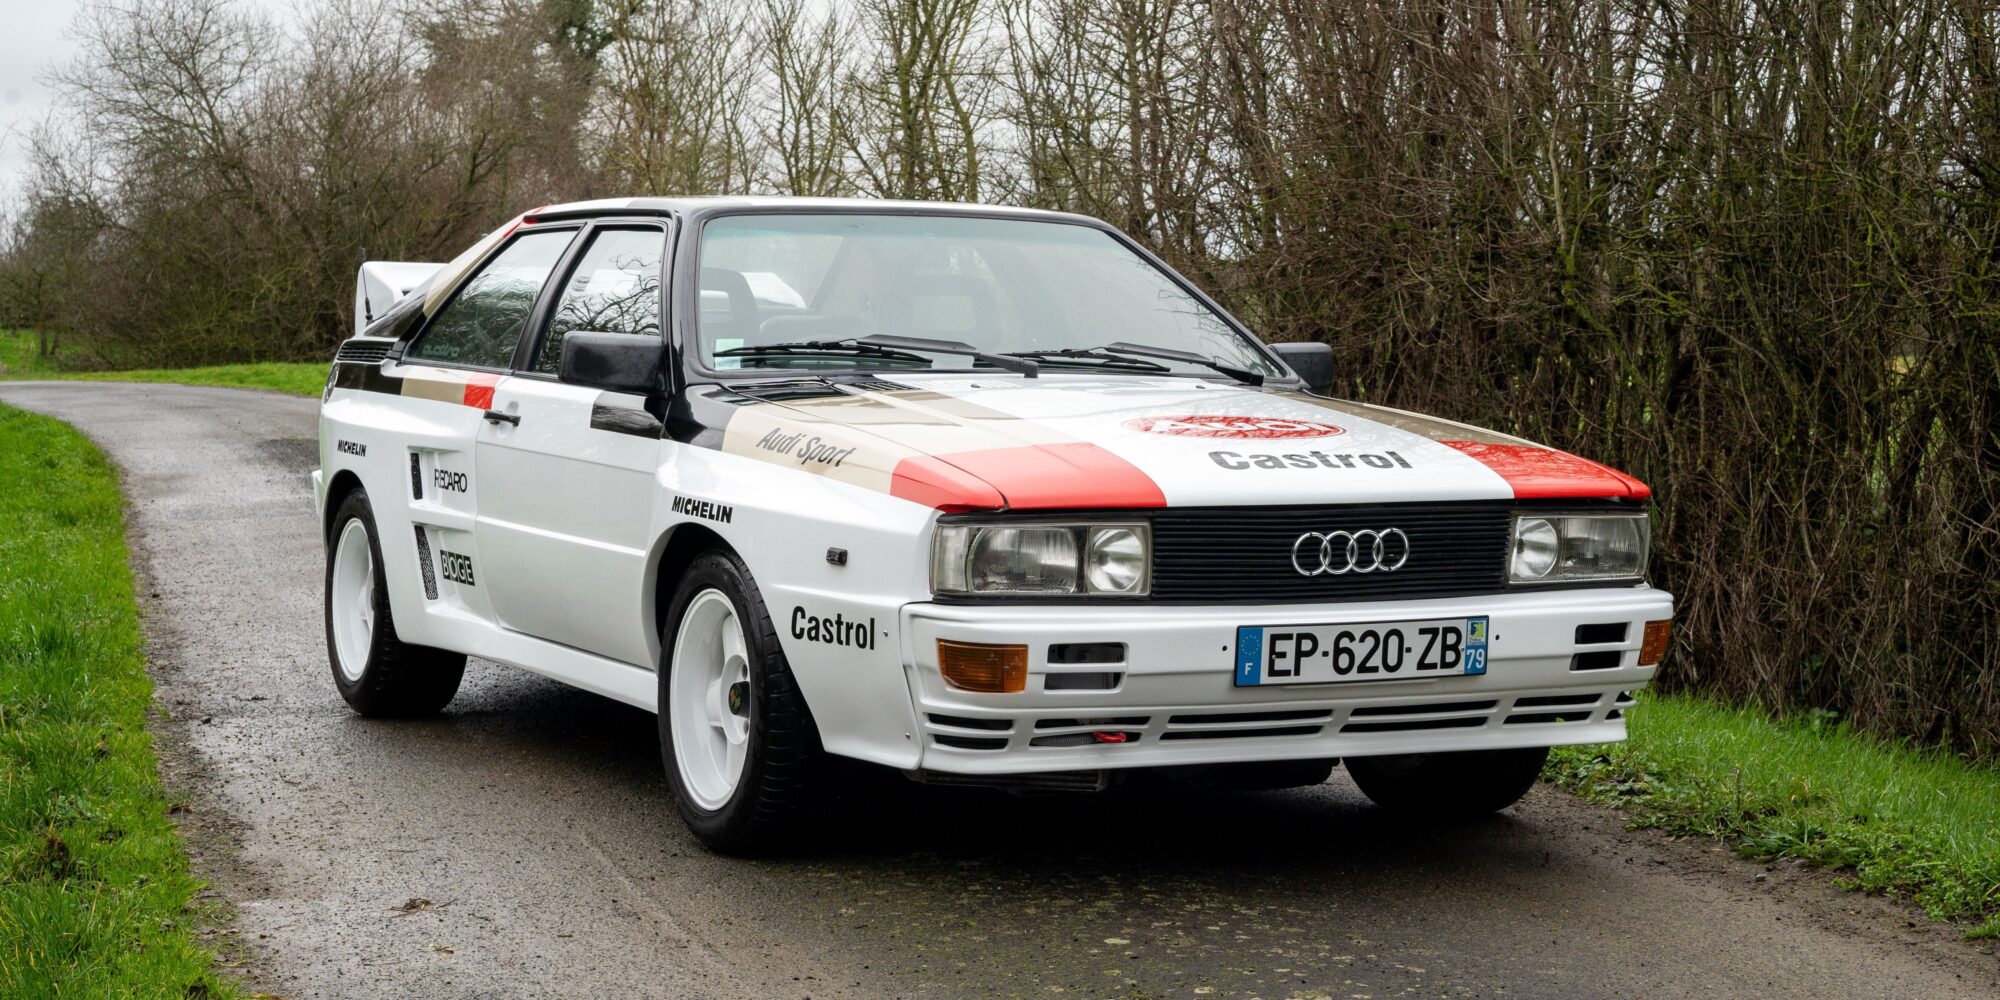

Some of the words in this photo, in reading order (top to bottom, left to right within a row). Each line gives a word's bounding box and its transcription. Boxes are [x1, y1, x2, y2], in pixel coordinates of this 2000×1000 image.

[337, 439, 367, 457] MICHELIN
[756, 427, 807, 454] Audi
[797, 437, 857, 467] Sport
[1208, 450, 1413, 471] Castrol
[434, 468, 468, 493] RECARO
[671, 495, 733, 524] MICHELIN
[441, 553, 474, 584] BOGE
[791, 605, 875, 650] Castrol
[1244, 662, 1253, 676] F
[1466, 648, 1485, 669] 79
